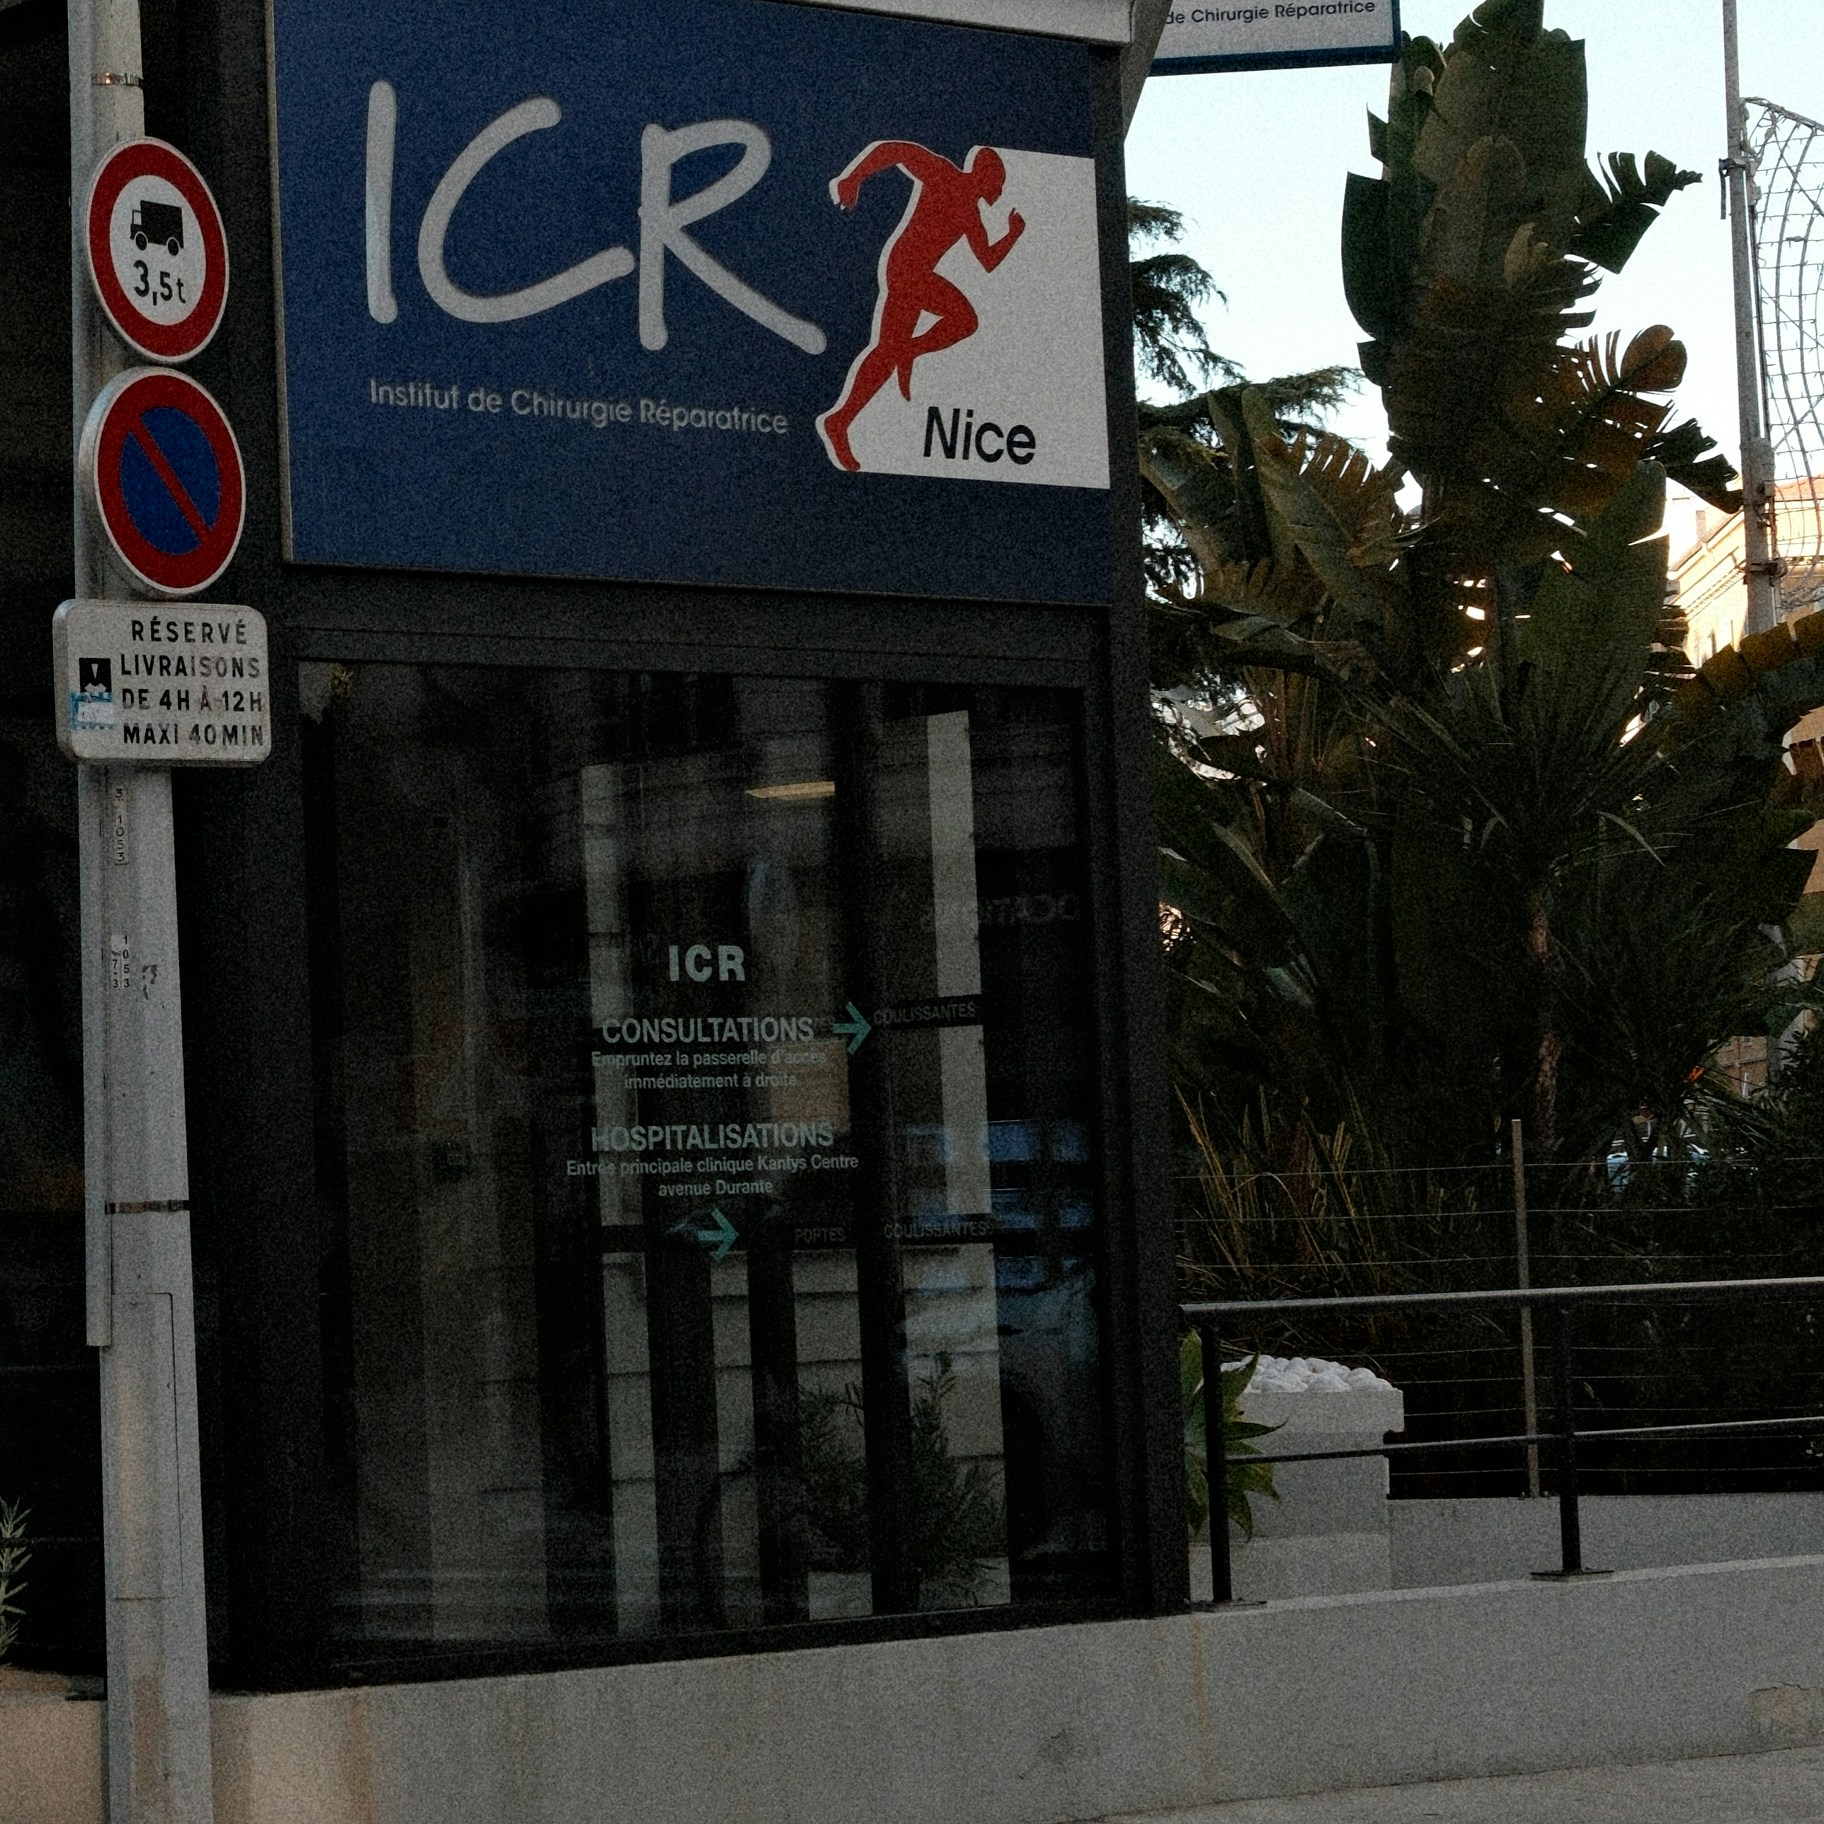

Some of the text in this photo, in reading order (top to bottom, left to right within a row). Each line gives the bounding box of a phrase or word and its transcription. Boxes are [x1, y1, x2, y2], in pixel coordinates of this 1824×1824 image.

[1190, 6, 1270, 24] Chirurgie
[1275, 0, 1376, 20] Réparatrice
[366, 80, 828, 355] ICR
[370, 378, 789, 434] Institut de Chirurgie Réparatrice
[923, 406, 1036, 465] Nice
[131, 616, 247, 644] RÉSERVÉ
[121, 654, 261, 678] LIVRAISONS
[122, 689, 150, 710] DE
[123, 723, 178, 745] MAXI
[668, 944, 746, 982] ICR
[873, 1001, 976, 1025] COULISSANTES
[602, 1017, 815, 1044] CONSULTATIONS
[591, 1050, 673, 1069] Empruntez
[676, 1050, 690, 1066] la
[693, 1049, 767, 1069] passerelle
[624, 1072, 798, 1090] immédiatement à droite
[590, 1122, 835, 1152] HOSPITALISATIONS
[566, 1153, 860, 1177] Entrée principale clinique Kantys Centre
[658, 1179, 774, 1197] avenue Durante
[795, 1228, 847, 1245] PORTES
